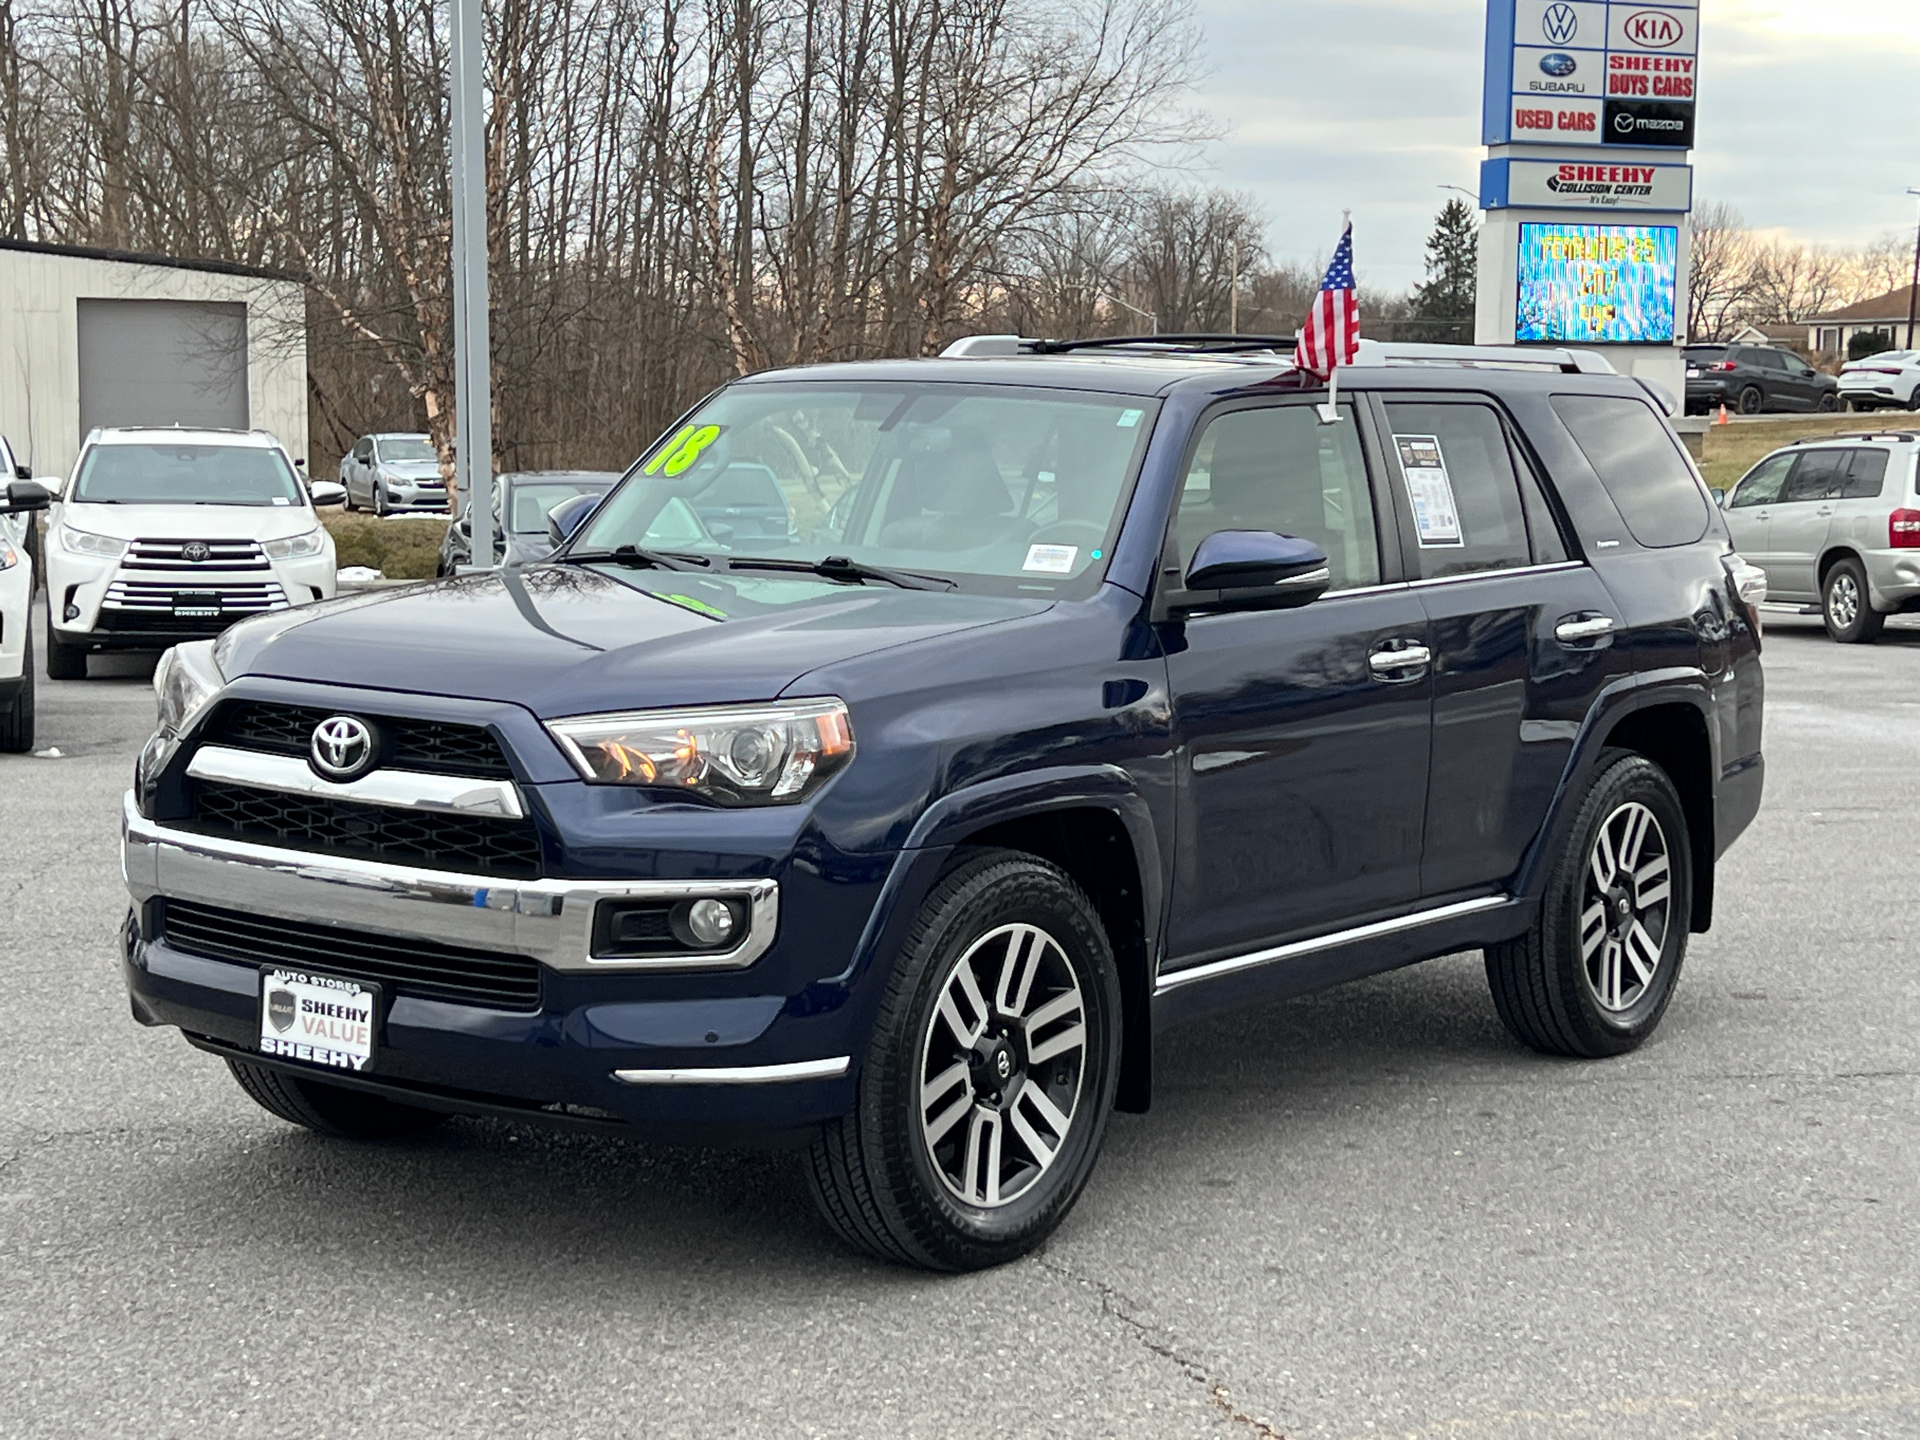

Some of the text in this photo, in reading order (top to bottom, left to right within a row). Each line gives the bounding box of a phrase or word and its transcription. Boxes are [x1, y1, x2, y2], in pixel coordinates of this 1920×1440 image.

[1635, 18, 1673, 40] KIA
[1609, 55, 1693, 73] SHEEHY
[1529, 81, 1585, 93] SUBARU
[1609, 73, 1693, 98] BUYS CARS
[1515, 109, 1596, 132] USED CARS
[1636, 118, 1684, 131] mazda
[1558, 165, 1655, 183] SHEEHY
[1558, 183, 1653, 196] COLLISION CENTER
[643, 424, 720, 477] 18
[273, 969, 361, 993] AUTO STORES
[301, 998, 369, 1023] SHEEHY
[302, 1015, 369, 1046] VALUE
[260, 1037, 368, 1071] SHEEHY
